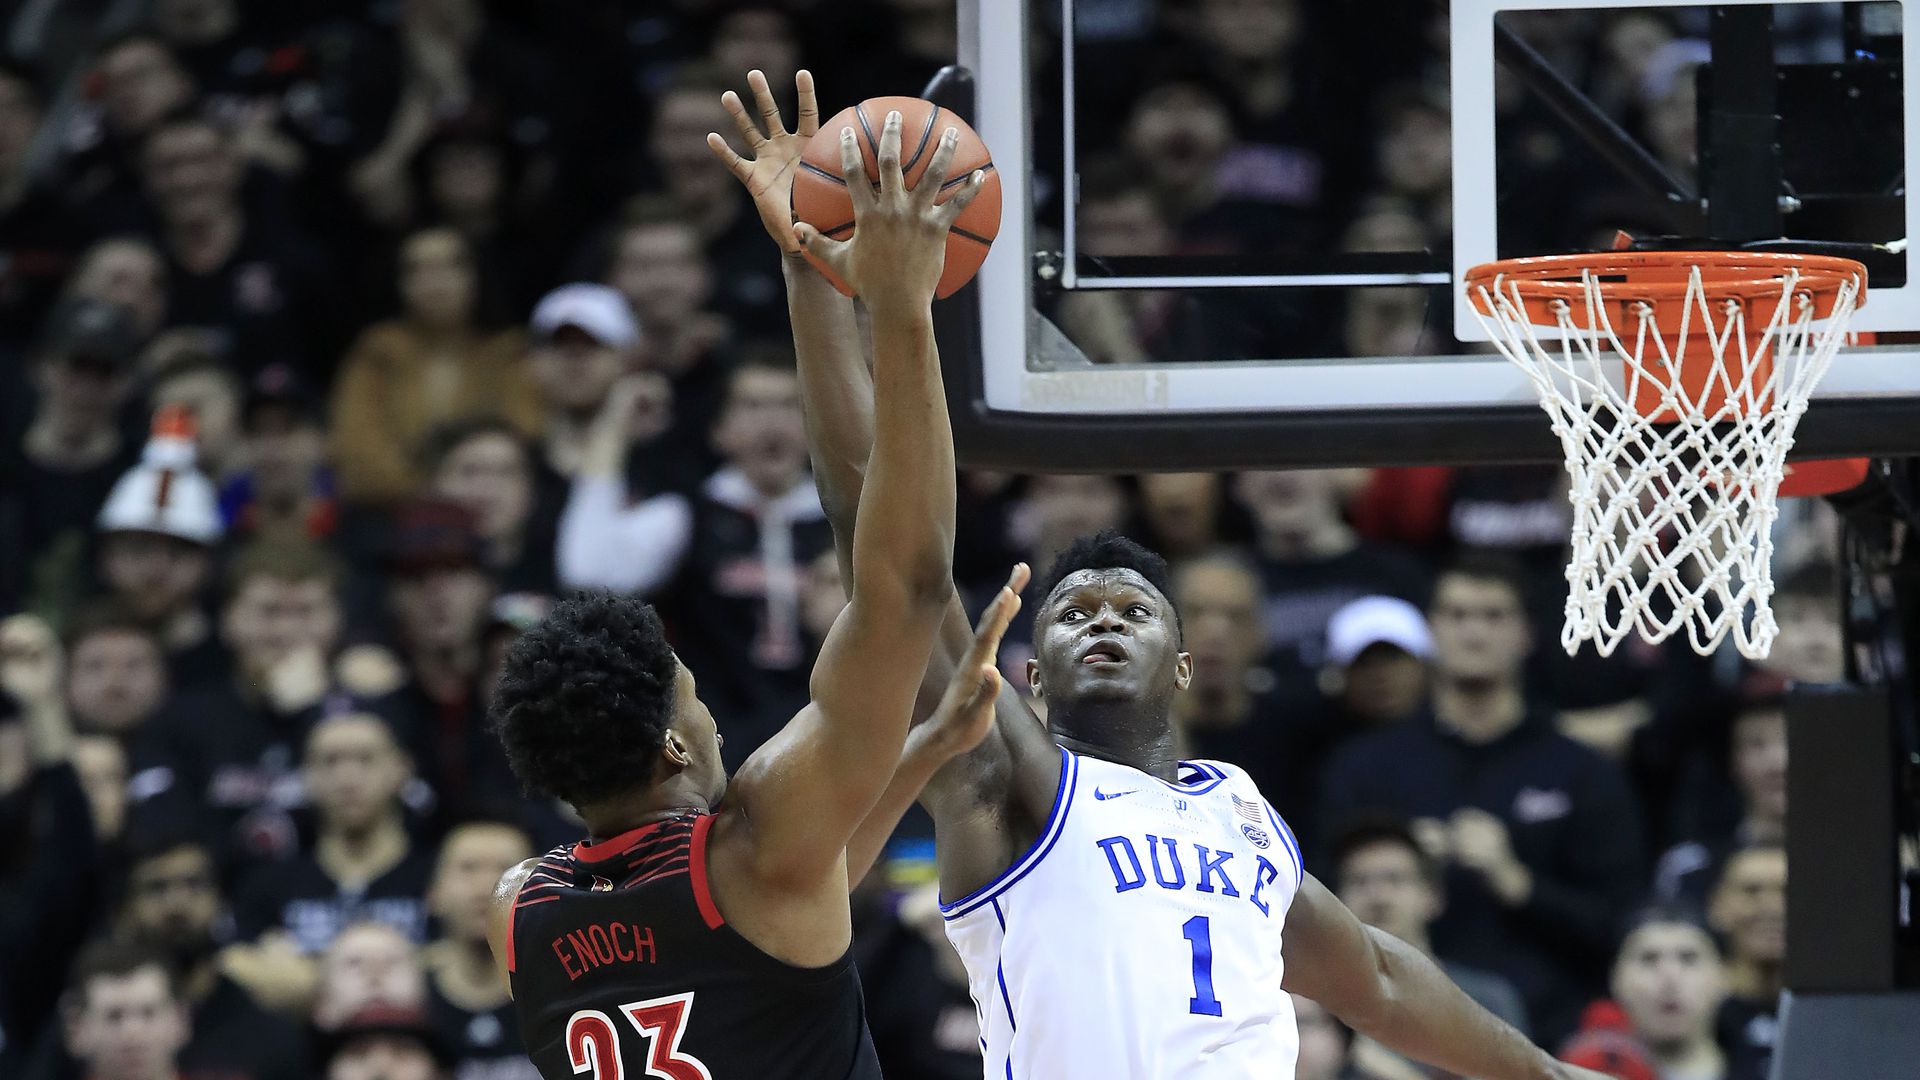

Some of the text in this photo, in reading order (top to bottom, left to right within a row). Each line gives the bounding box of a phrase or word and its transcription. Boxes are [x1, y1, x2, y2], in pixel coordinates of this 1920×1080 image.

[1096, 834, 1279, 918] DUKE
[552, 921, 657, 981] ENOCH
[1182, 915, 1223, 1018] 1
[565, 991, 714, 1080] 23
